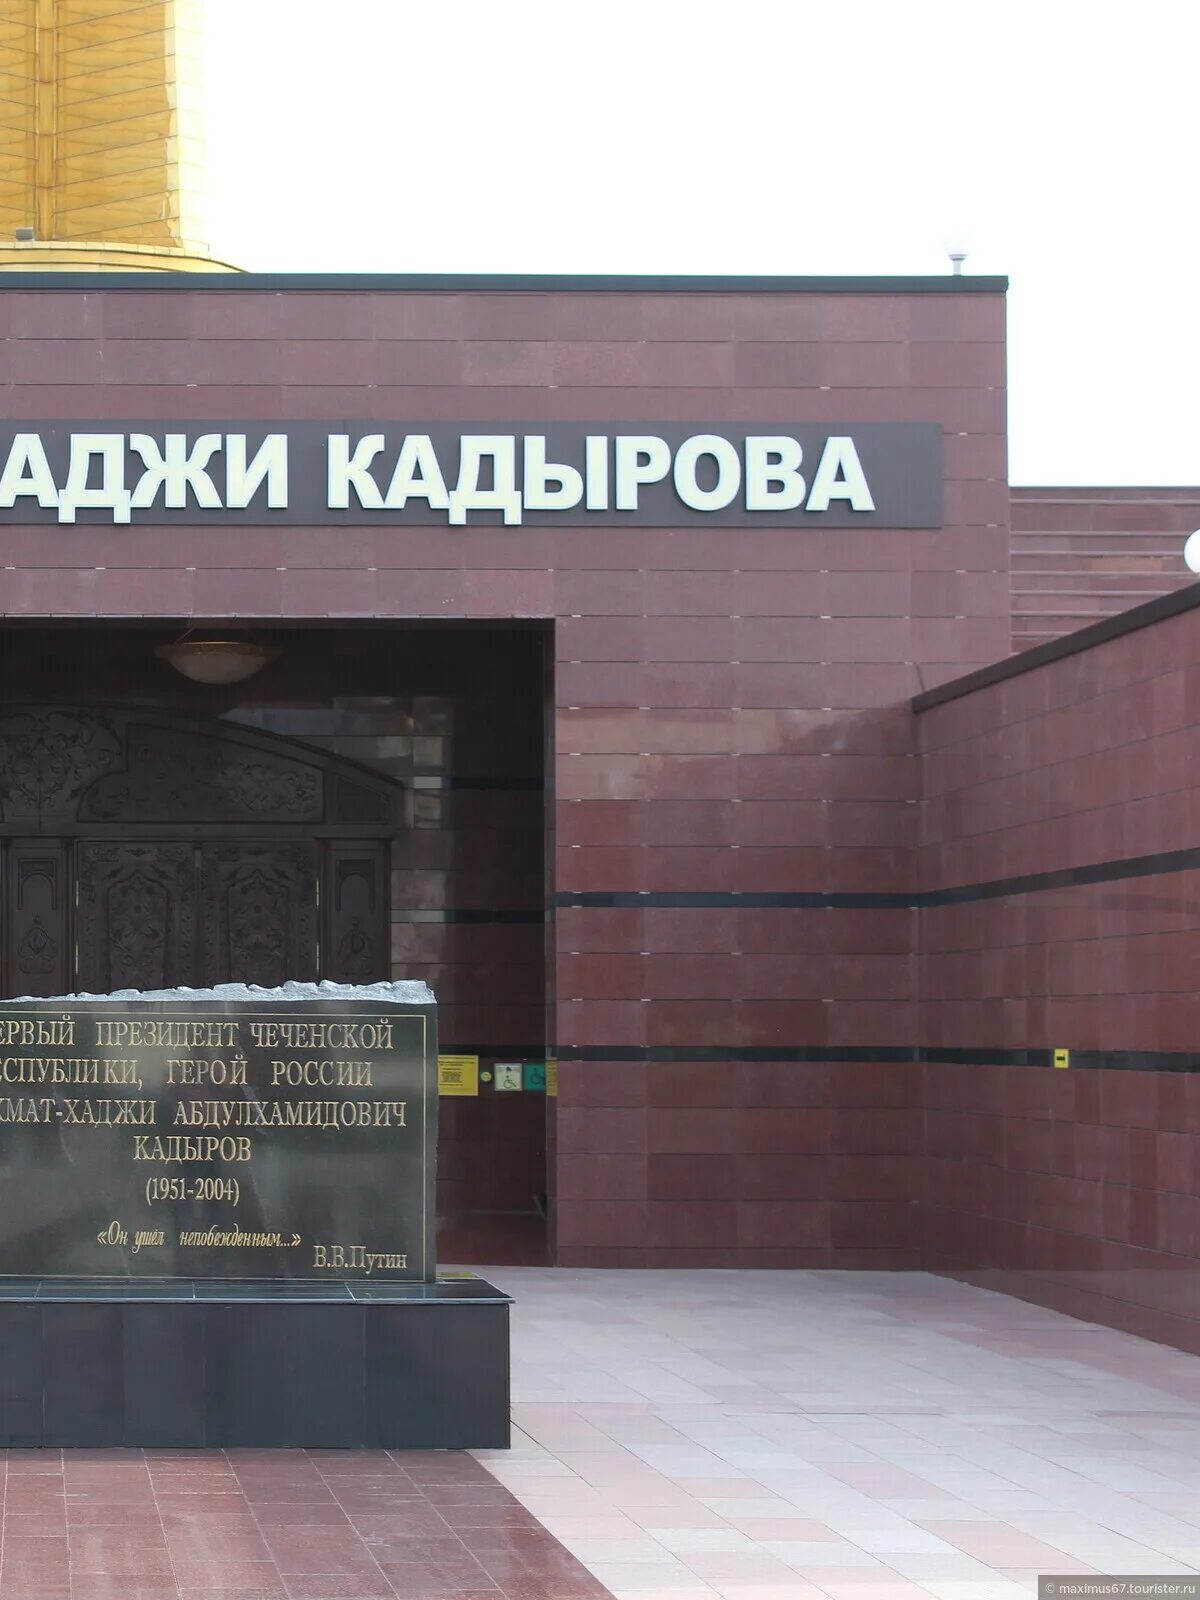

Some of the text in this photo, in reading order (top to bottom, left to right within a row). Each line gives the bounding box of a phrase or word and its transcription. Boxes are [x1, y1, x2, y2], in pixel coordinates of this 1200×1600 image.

[327, 433, 876, 526] КАДЫРОВА
[95, 1021, 240, 1051] ПРЕЗИДЕНТ
[249, 1017, 395, 1049] ЧЕЧЕНСКОЙ
[166, 1053, 249, 1085] ГЕРОЙ
[270, 1060, 374, 1087] РОССИИ
[172, 1100, 408, 1130] АБДУЛХАМИДОВИЧ
[132, 1135, 252, 1164] КАДЫРОВ
[145, 1177, 240, 1207] (1951-2004)
[97, 1220, 128, 1246] «Он
[312, 1245, 408, 1275] В.В.Путин
